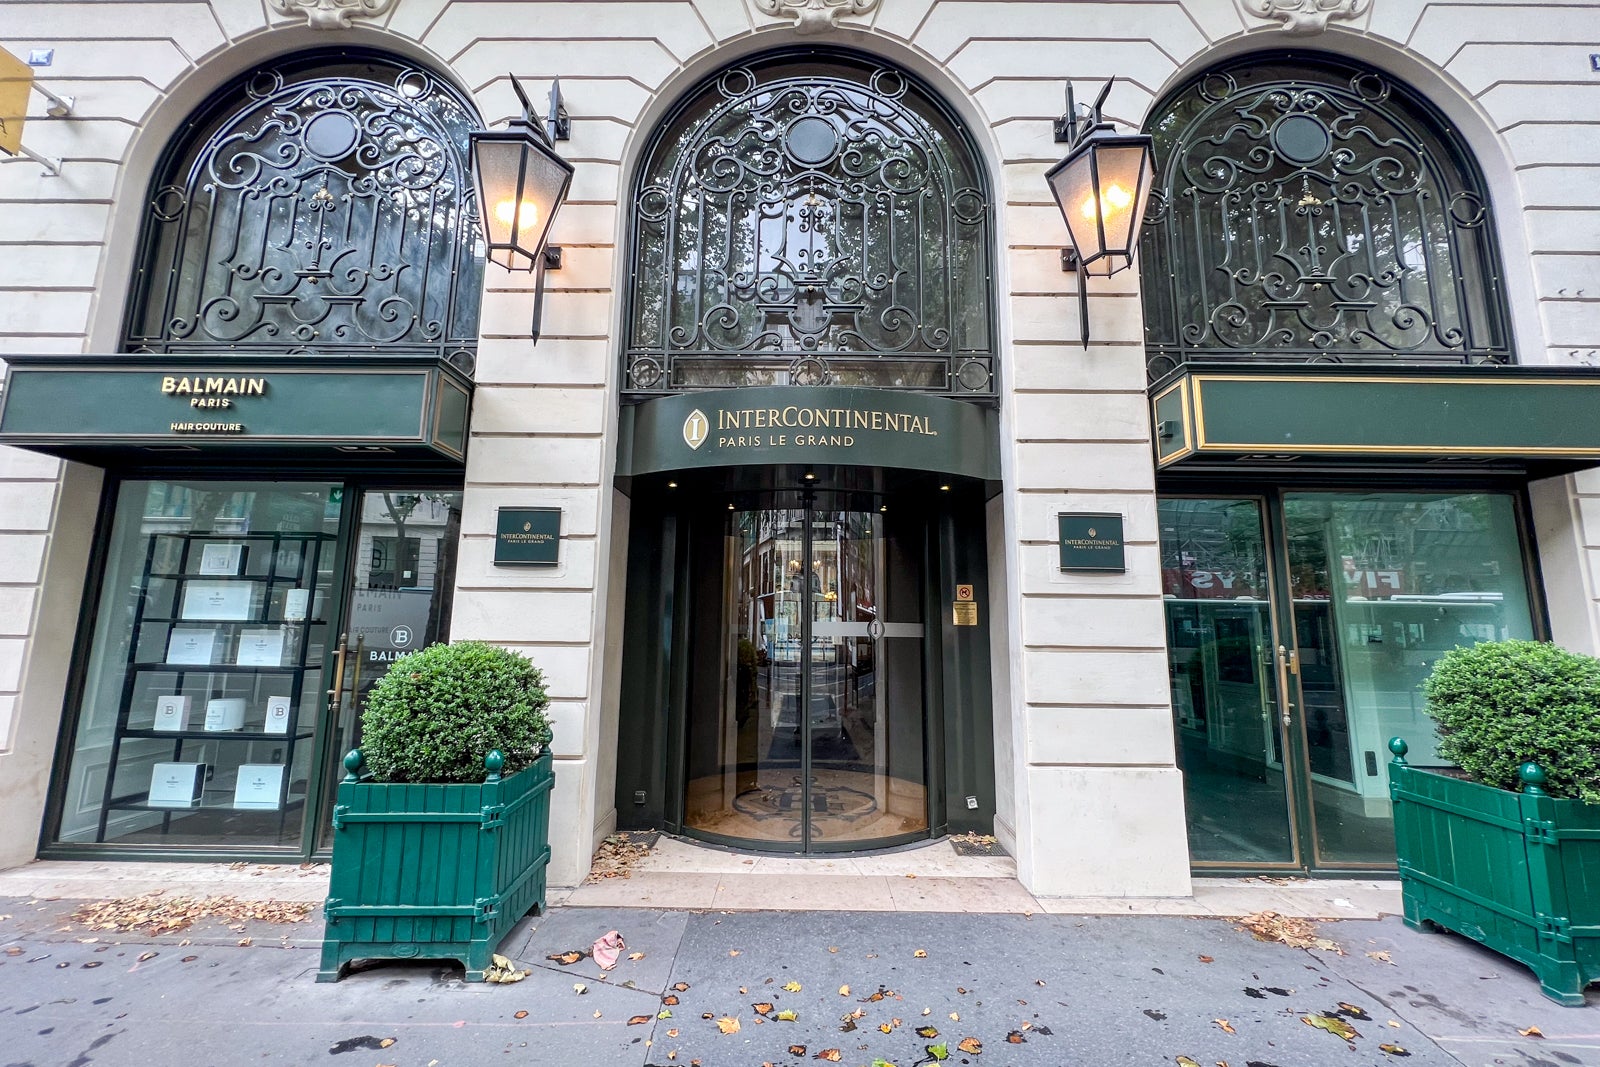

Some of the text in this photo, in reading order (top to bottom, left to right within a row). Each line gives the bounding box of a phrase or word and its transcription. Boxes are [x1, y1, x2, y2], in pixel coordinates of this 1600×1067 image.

[162, 377, 264, 394] BALMAIN
[190, 398, 229, 407] PARIS
[171, 422, 242, 431] HAIR COUTURE
[717, 406, 936, 436] INTERCONTINENTAL
[719, 435, 854, 448] PARIS LE GRAND
